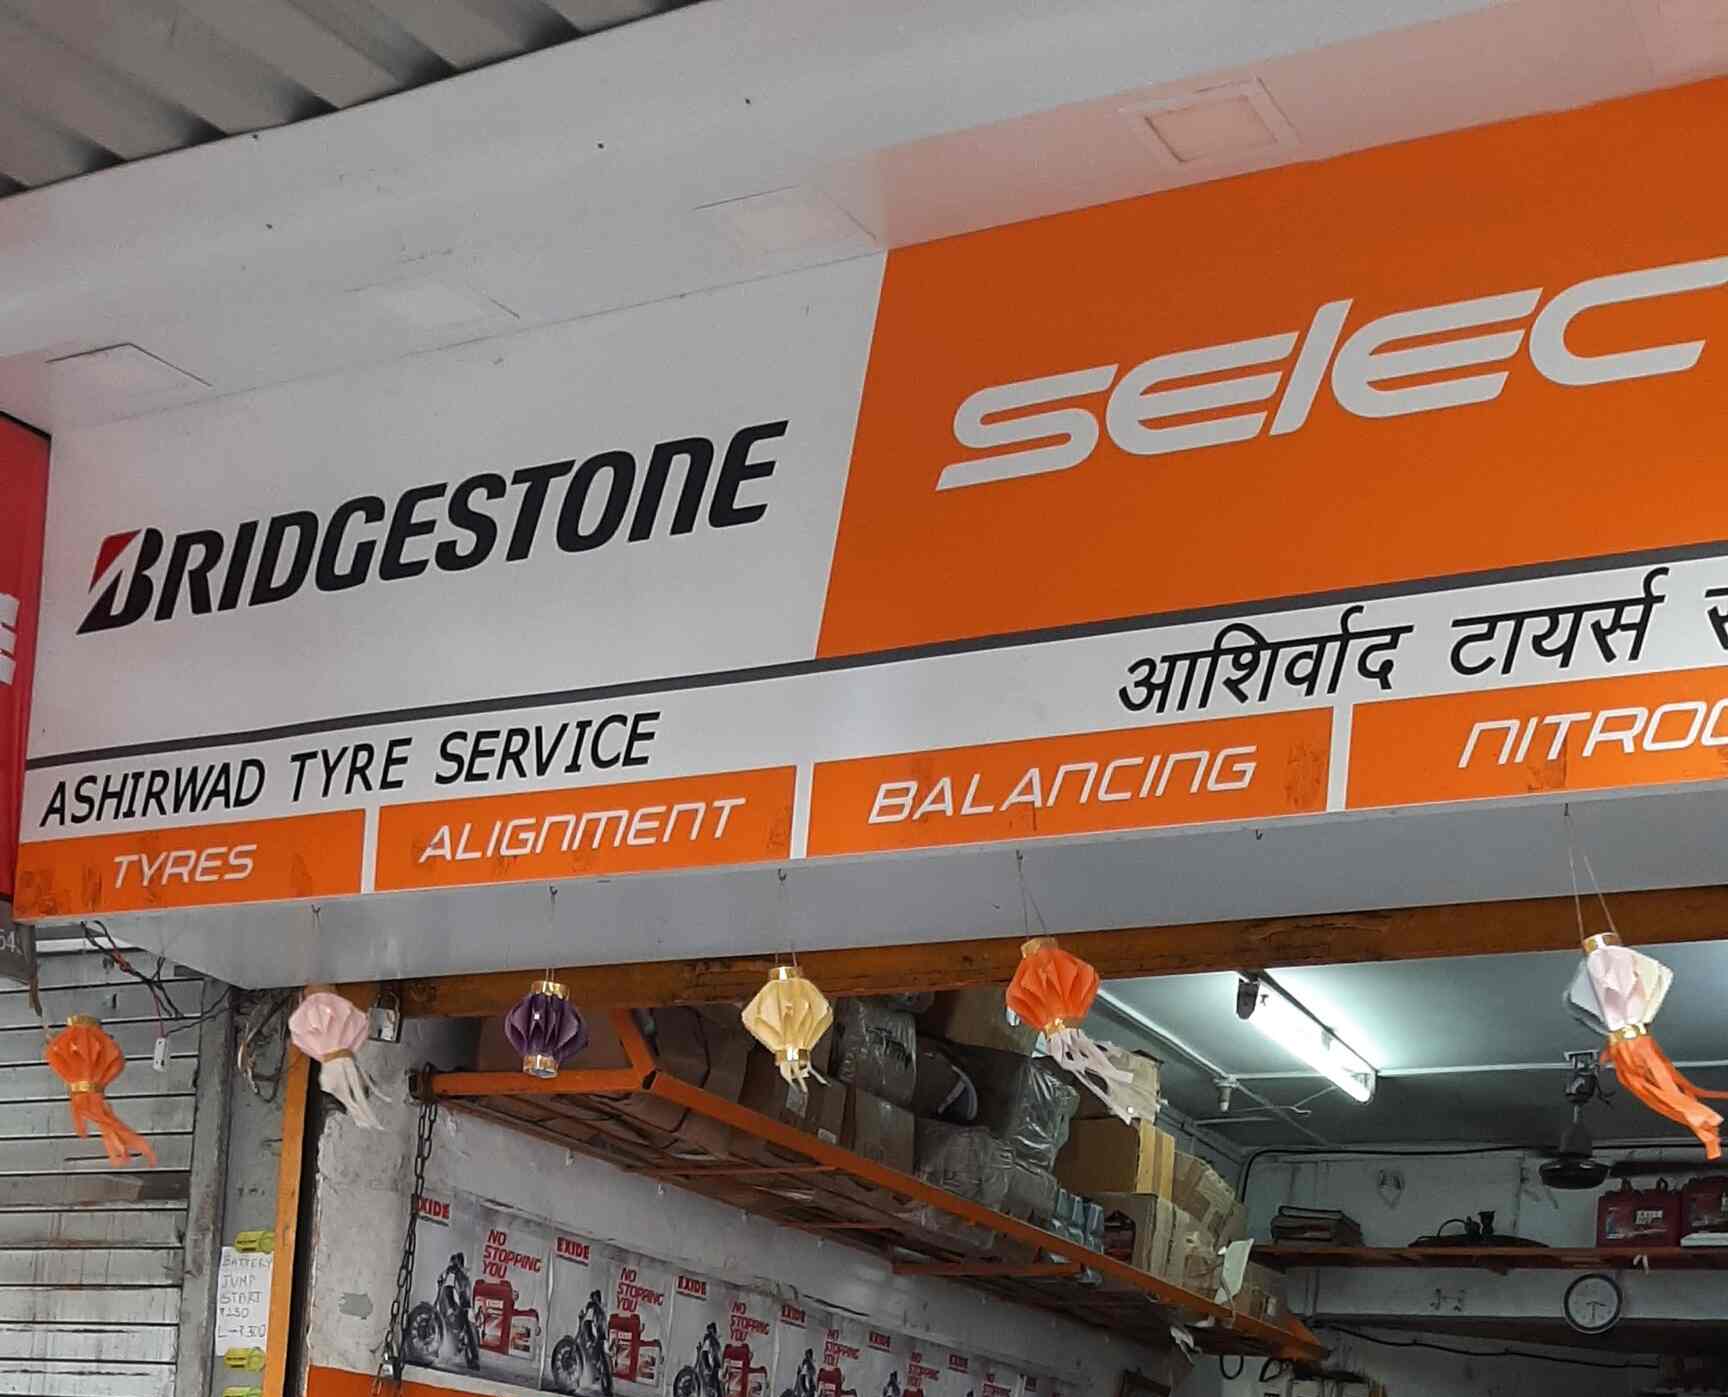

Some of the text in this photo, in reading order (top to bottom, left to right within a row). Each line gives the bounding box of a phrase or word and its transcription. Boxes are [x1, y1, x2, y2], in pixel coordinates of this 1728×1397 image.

[76, 420, 788, 635] BRIDGESTONE
[1119, 605, 1414, 713] आशिर्वाद
[1450, 567, 1669, 675] टायर्स
[39, 712, 660, 828] ASHIRWAD TYRE SERVICE
[868, 746, 1258, 824] BALANCING
[419, 798, 746, 863] ALIGNMENT
[114, 844, 257, 888] TYRES
[414, 1197, 450, 1219] XIDE
[488, 1229, 507, 1246] NO
[557, 1237, 590, 1260] EXIDE
[482, 1261, 508, 1279] YOU
[483, 1245, 544, 1273] STOPPING
[621, 1268, 637, 1283] NO
[616, 1296, 638, 1313] YOU
